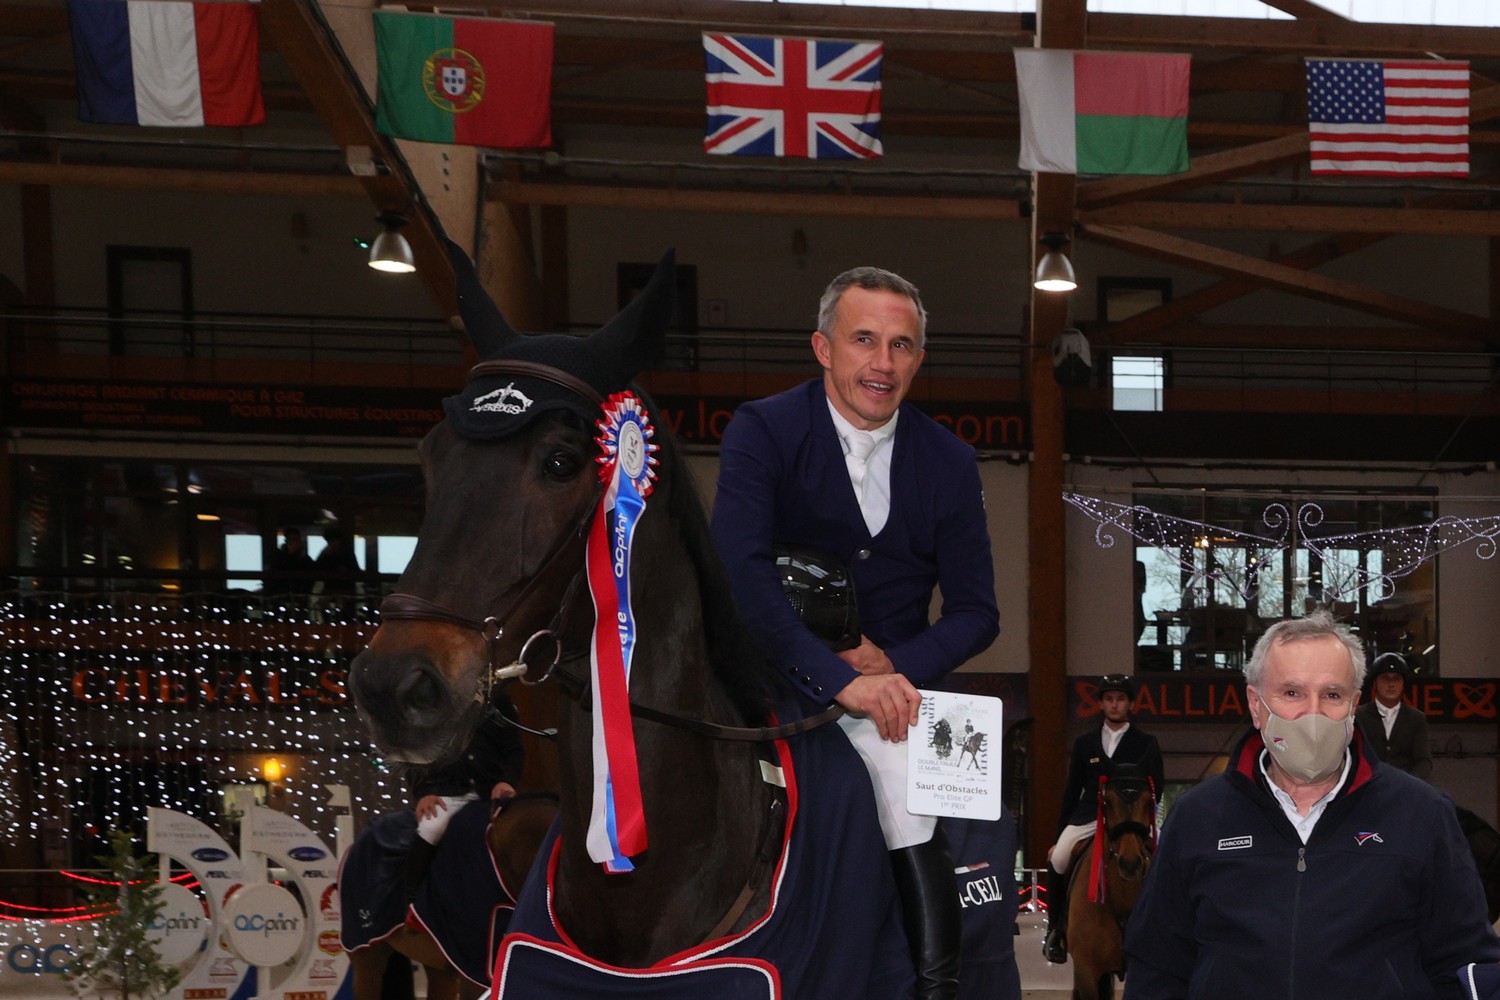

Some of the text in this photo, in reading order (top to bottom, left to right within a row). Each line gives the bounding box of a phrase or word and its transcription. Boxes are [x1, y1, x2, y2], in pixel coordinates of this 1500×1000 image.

[1132, 682, 1248, 716] ALLIA
[916, 781, 988, 796] Saut d'Obstacles
